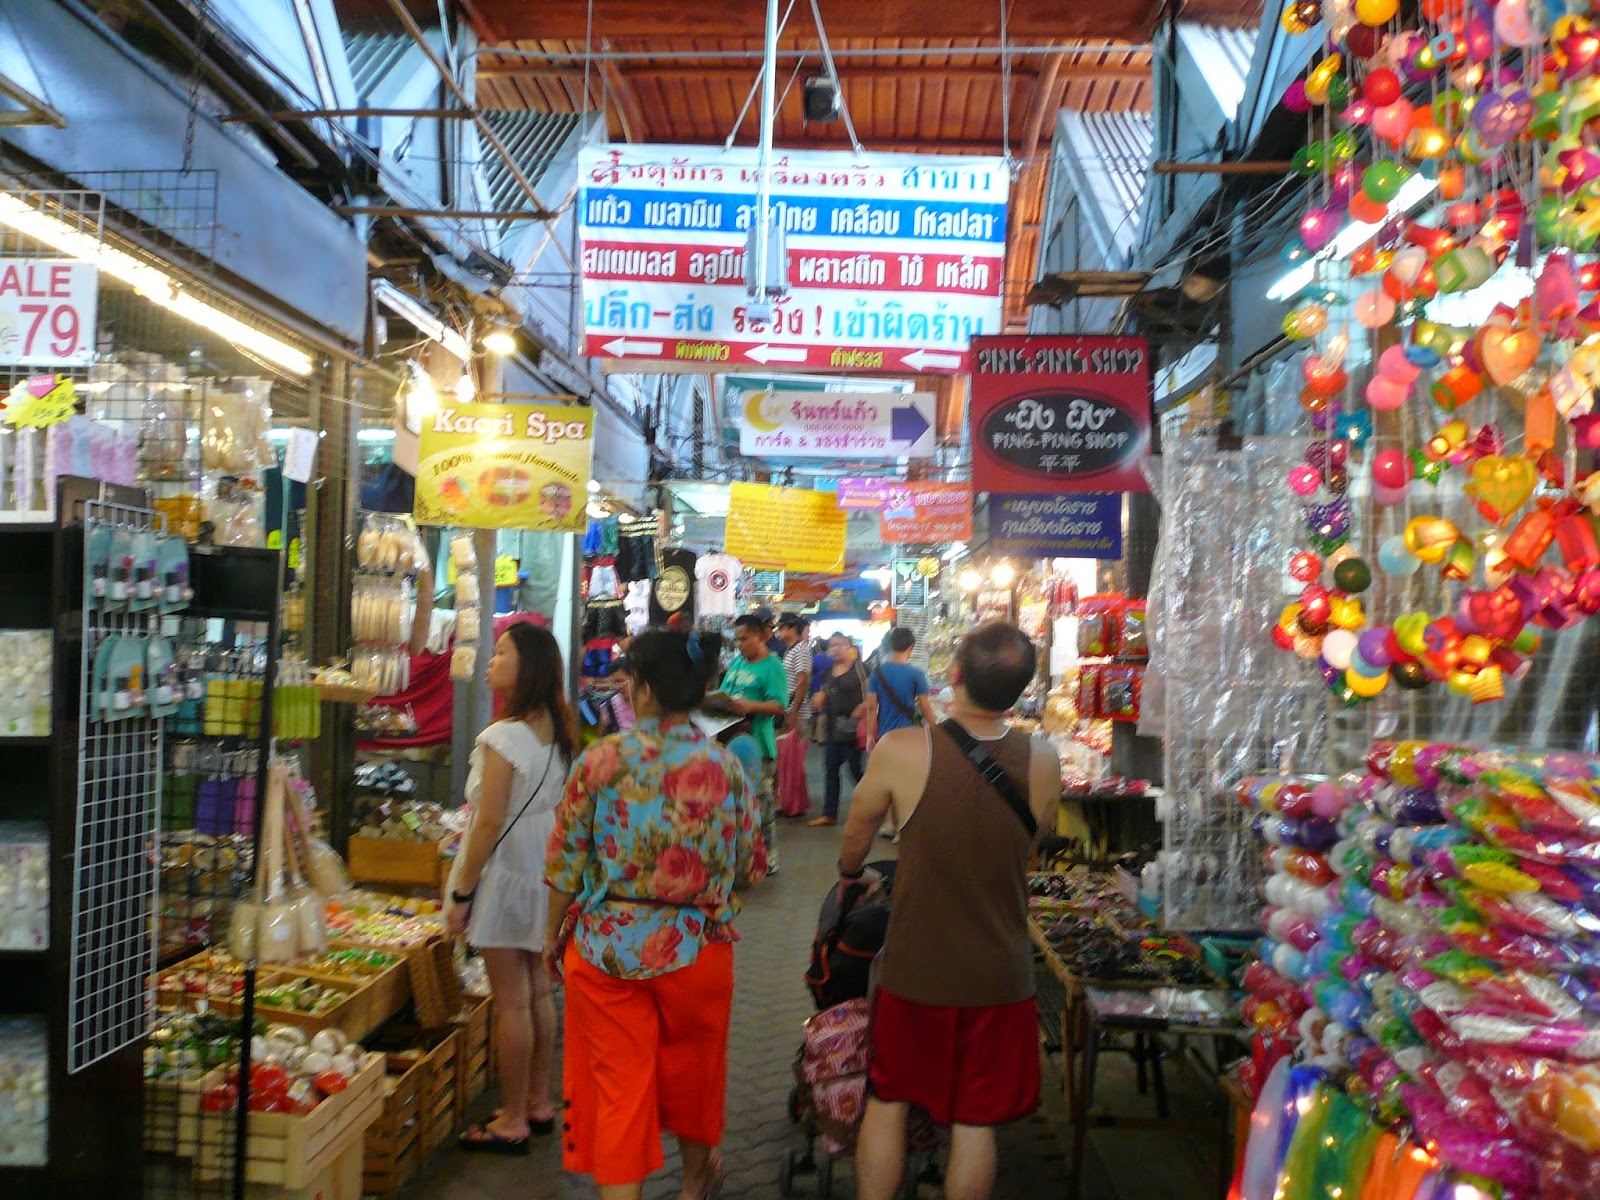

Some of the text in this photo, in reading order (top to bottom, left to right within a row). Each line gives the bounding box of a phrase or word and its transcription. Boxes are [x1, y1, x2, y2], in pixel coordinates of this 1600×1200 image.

[588, 193, 632, 225] แก้ว
[644, 198, 723, 227] เมลามีน
[830, 203, 900, 236] เคลือบ
[913, 205, 994, 240] โหลปลา
[582, 247, 677, 277] สแตนเลส
[799, 253, 886, 286] พลาสติก
[897, 254, 925, 287] ไม้
[935, 252, 989, 291] เหล็ก
[585, 287, 715, 332] ปลีก-ส่ง
[526, 411, 587, 444] Spa
[790, 399, 879, 423] จันทร์แก้ว
[992, 431, 1130, 450] PING-PING SHOP
[432, 452, 473, 477] 100%
